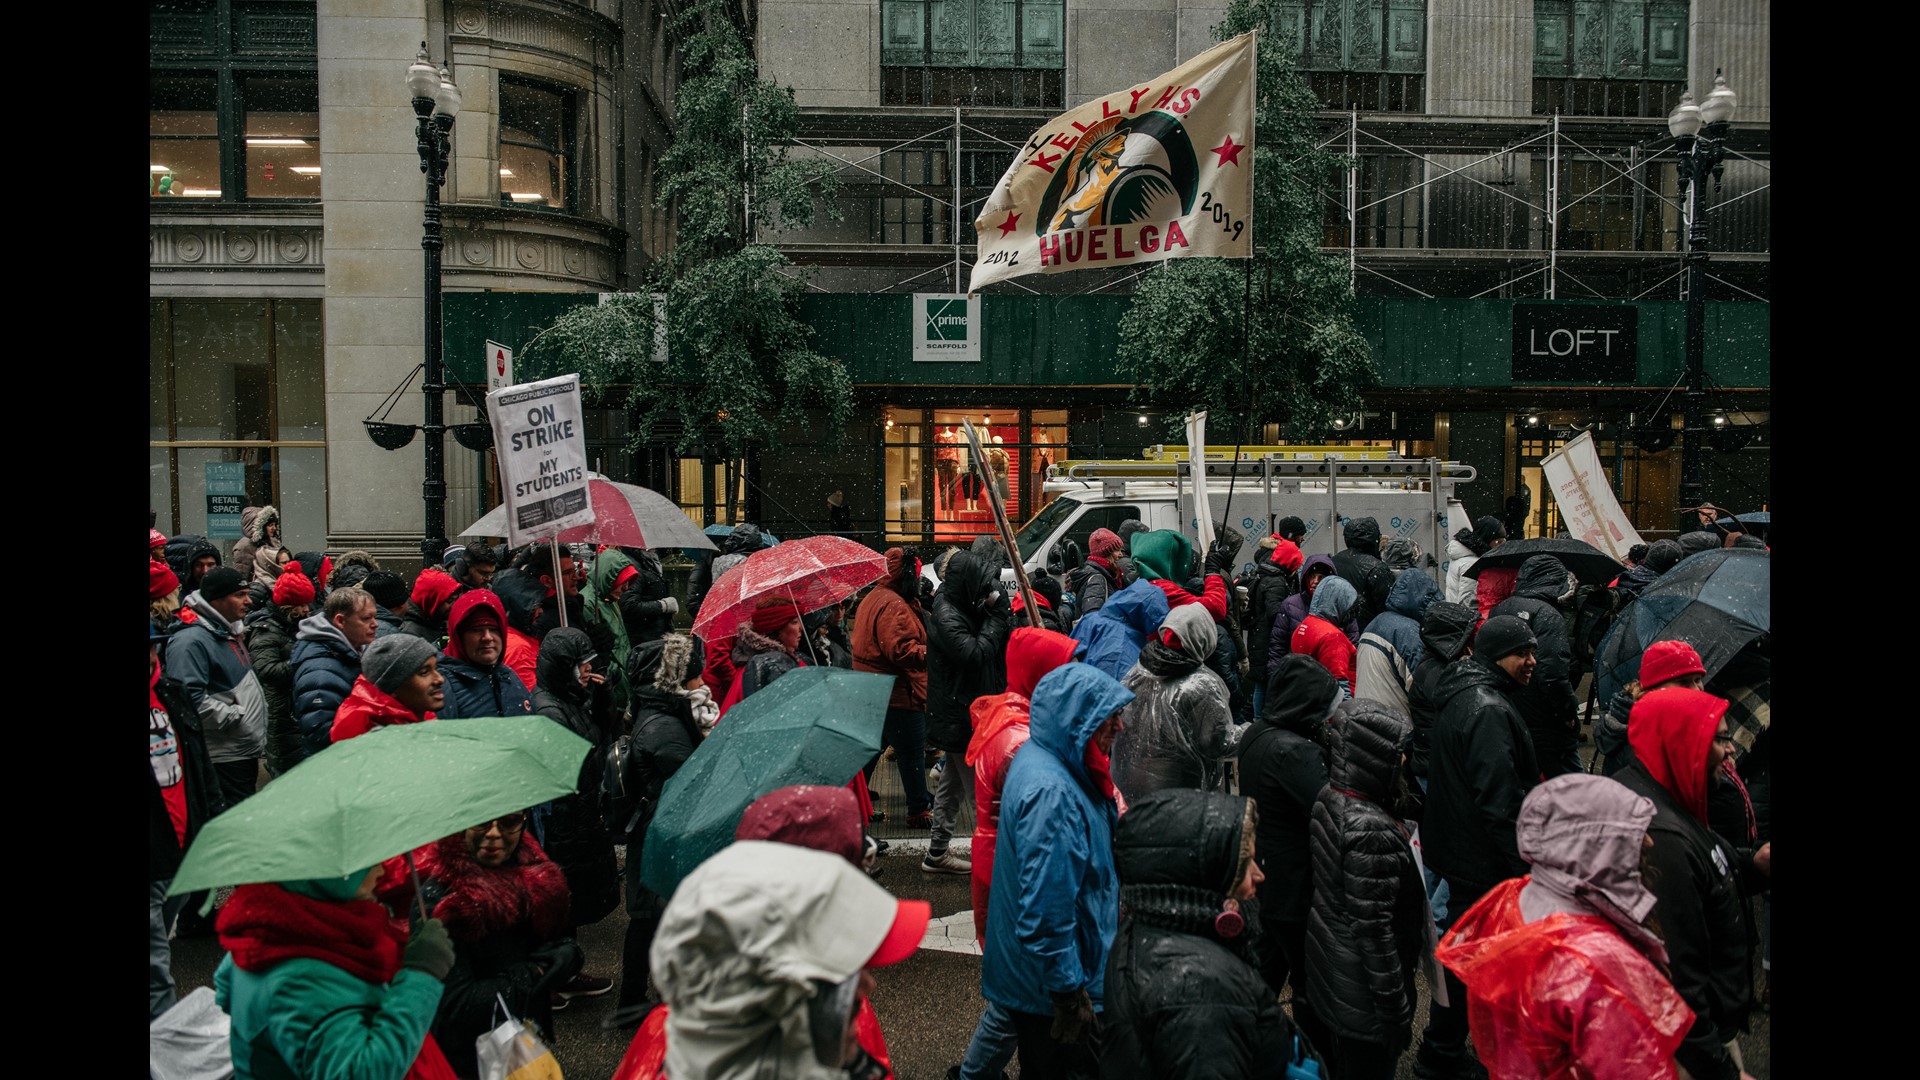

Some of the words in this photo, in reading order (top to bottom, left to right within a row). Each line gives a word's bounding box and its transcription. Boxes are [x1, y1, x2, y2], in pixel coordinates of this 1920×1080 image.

[1028, 87, 1150, 174] KELLY
[1200, 191, 1244, 242] 2019
[1039, 220, 1189, 267] HUELGA
[983, 250, 1019, 267] 2012
[1530, 328, 1619, 356] LOFT
[500, 393, 528, 404] CHICAGO
[529, 389, 548, 399] PUBLIC
[548, 384, 574, 395] SCHOOLS
[527, 403, 556, 427] ON
[511, 419, 574, 452] STRIKE
[539, 457, 558, 476] MY
[516, 466, 583, 497] STUDENTS
[212, 496, 240, 504] RETAIL
[213, 505, 240, 513] SPACE
